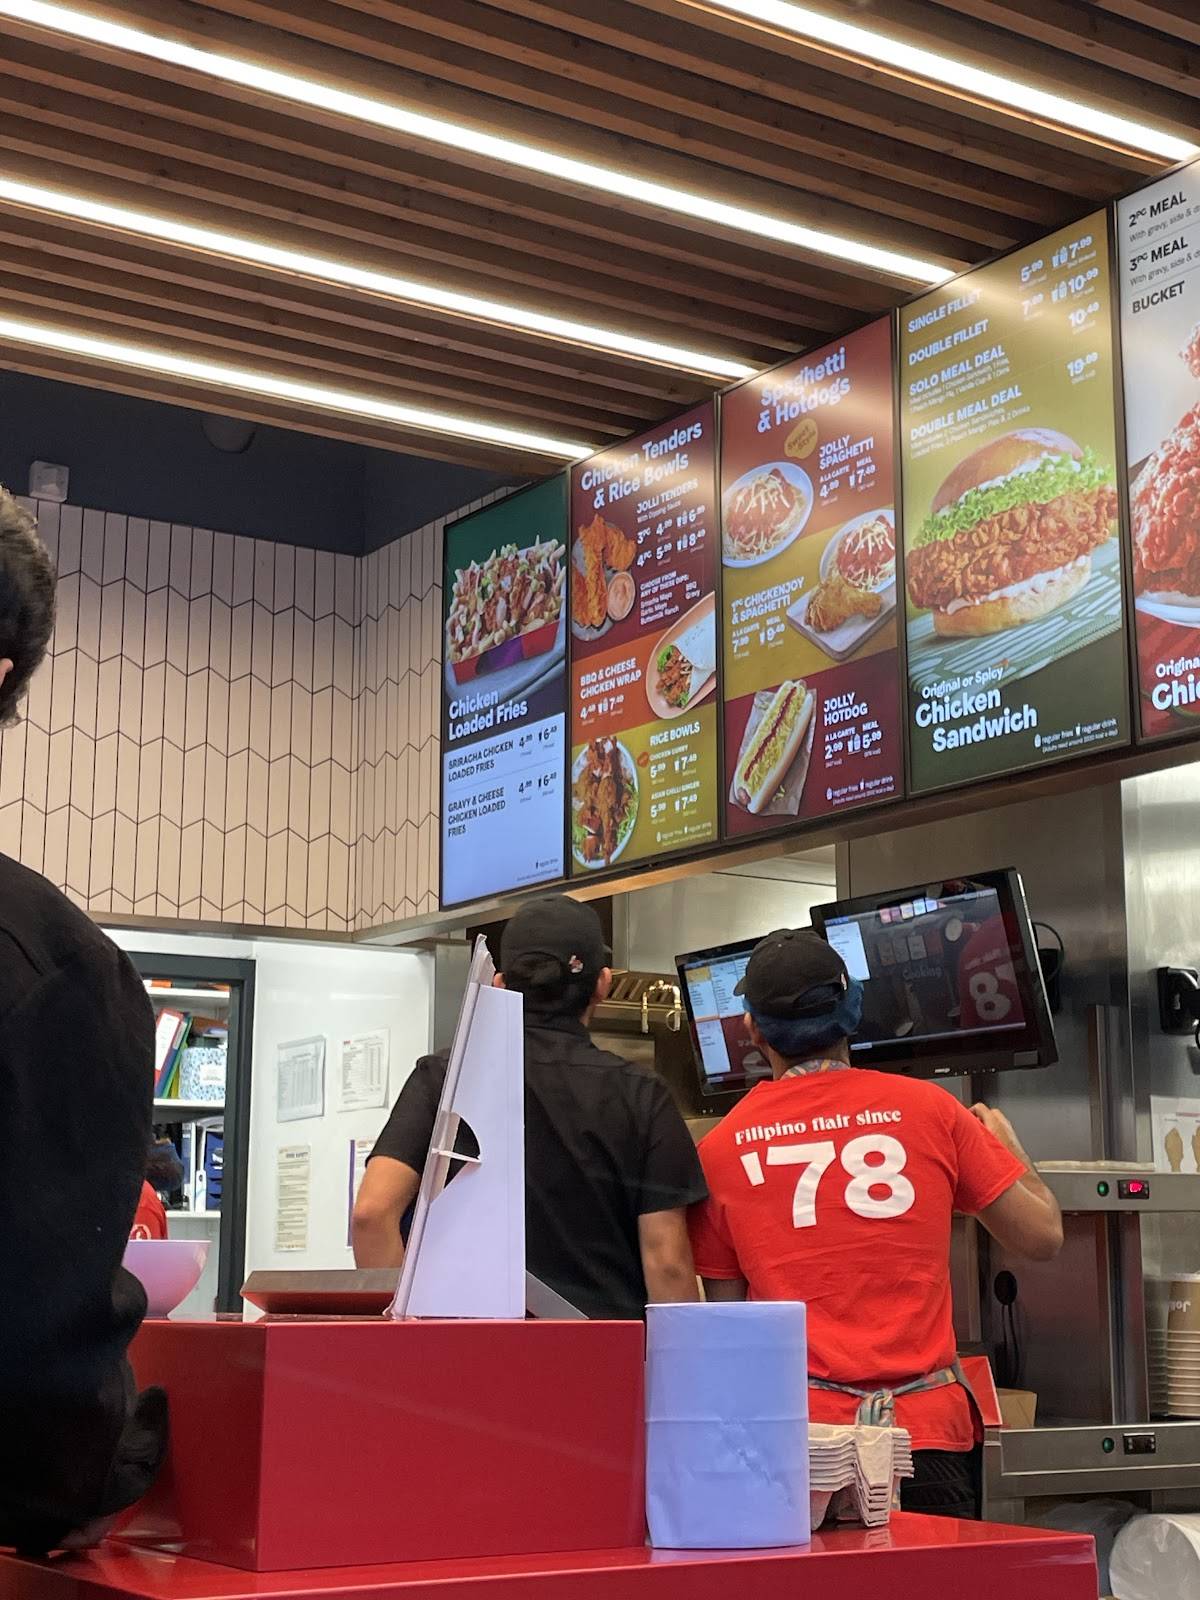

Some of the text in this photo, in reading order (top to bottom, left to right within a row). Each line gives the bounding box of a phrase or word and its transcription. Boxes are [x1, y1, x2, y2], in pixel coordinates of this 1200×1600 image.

[1150, 192, 1187, 217] MEAL
[1129, 230, 1146, 242] With
[1151, 236, 1188, 262] MEAL
[1130, 274, 1147, 286] With
[908, 288, 982, 334] SINGLE FILLET
[1132, 280, 1185, 314] BUCKET
[909, 319, 989, 365] DOUBLE FILLET
[761, 346, 846, 407] Spaghetti
[909, 374, 939, 396] SOLO
[941, 359, 973, 382] MEAL
[974, 345, 1005, 367] DEAL
[757, 377, 850, 433] & Hotdogs
[910, 412, 955, 440] DOUBLE
[956, 399, 989, 421] MEAL
[991, 385, 1022, 407] DEAL
[581, 422, 703, 491] Chicken Tenders
[819, 435, 850, 458] JOLLY
[820, 436, 874, 470] SPAGHETTI
[593, 453, 689, 509] & Rice Bowls
[637, 478, 699, 514] JOLLI TENDERS
[744, 576, 805, 608] CHICKENJOY
[731, 594, 791, 625] & SPAGHETTI
[580, 657, 636, 686] BBQ & CHEESE
[580, 669, 642, 699] CHICKEN WRAP
[922, 667, 1003, 699] Original or Spicy
[449, 690, 499, 720] Chicken
[823, 691, 855, 713] JOLLY
[824, 702, 868, 727] HOTDOG
[915, 688, 1001, 728] Chicken
[448, 700, 528, 741] Loaded Fries
[650, 721, 700, 747] RICE BOWLS
[837, 726, 856, 739] CARTE
[862, 720, 879, 732] MEAL
[932, 704, 1038, 752] Sandwich
[449, 740, 514, 770] SRIRACHA CHICKEN
[448, 759, 495, 783] LOADED FRIES
[448, 798, 471, 813] GRAVY
[478, 787, 504, 803] CHEESE
[448, 800, 506, 825] CHICKEN LOADED
[448, 824, 466, 838] FRIES
[735, 1109, 902, 1146] Filipino flair since
[740, 1134, 916, 1229] '78
